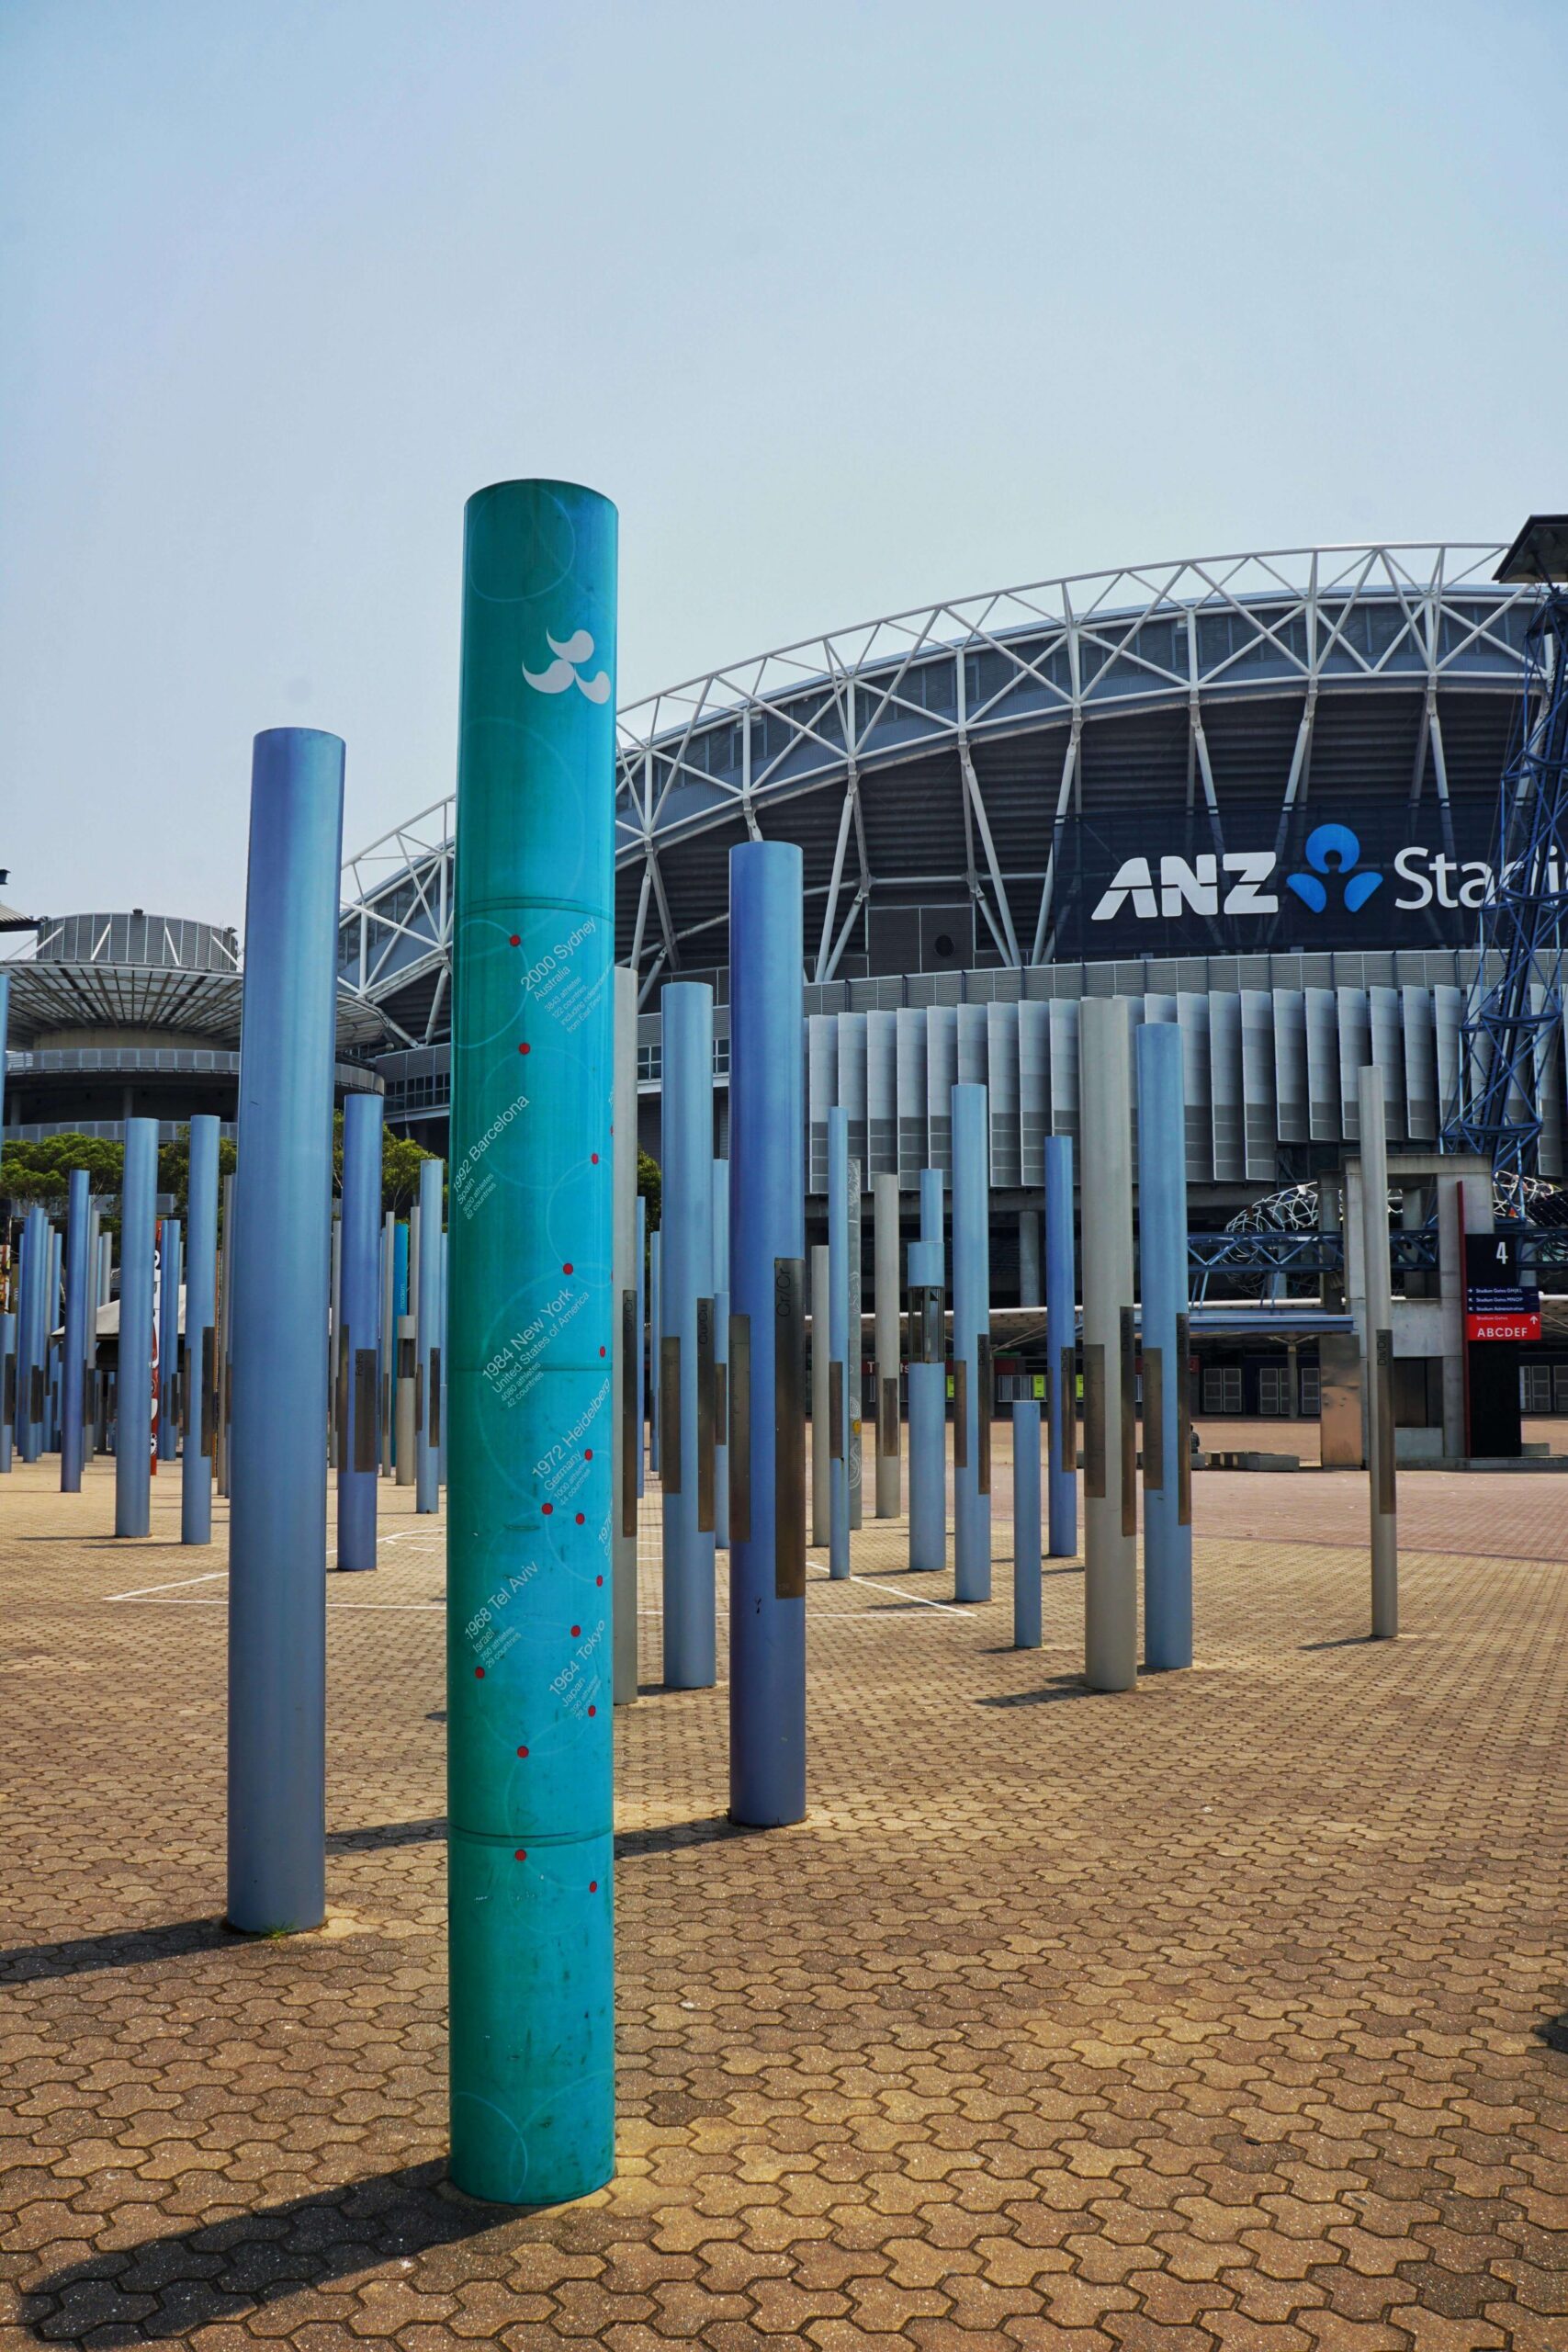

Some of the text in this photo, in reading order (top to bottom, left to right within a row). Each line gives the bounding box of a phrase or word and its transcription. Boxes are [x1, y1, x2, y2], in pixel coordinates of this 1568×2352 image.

[1090, 844, 1568, 921] ANZ Stadi
[521, 917, 596, 991] 2000 Sydney
[534, 966, 570, 1001] Australia
[560, 976, 581, 999] athletes
[453, 1095, 530, 1193] 1992 Barcelona
[457, 1177, 476, 1204] Spain
[471, 1182, 497, 1211] countries
[473, 1172, 494, 1197] athletes
[1495, 1241, 1508, 1264] 4
[776, 1268, 791, 1317] Cr/Cr
[482, 1287, 574, 1381] 1984 New York
[491, 1291, 591, 1394] United States of America
[1477, 1328, 1528, 1337] ABCDEF
[515, 1371, 545, 1400] countries
[516, 1361, 541, 1386] athletes
[532, 1377, 610, 1478] 1972 Heidelberg
[544, 1450, 581, 1490] Germany
[465, 1560, 538, 1640] 1968 Tel Aviv
[472, 1626, 495, 1653] Israel
[491, 1626, 515, 1649] athletes
[494, 1632, 522, 1660] countries
[548, 1620, 605, 1696] 1964 Tokyo
[561, 1677, 586, 1707] Japan
